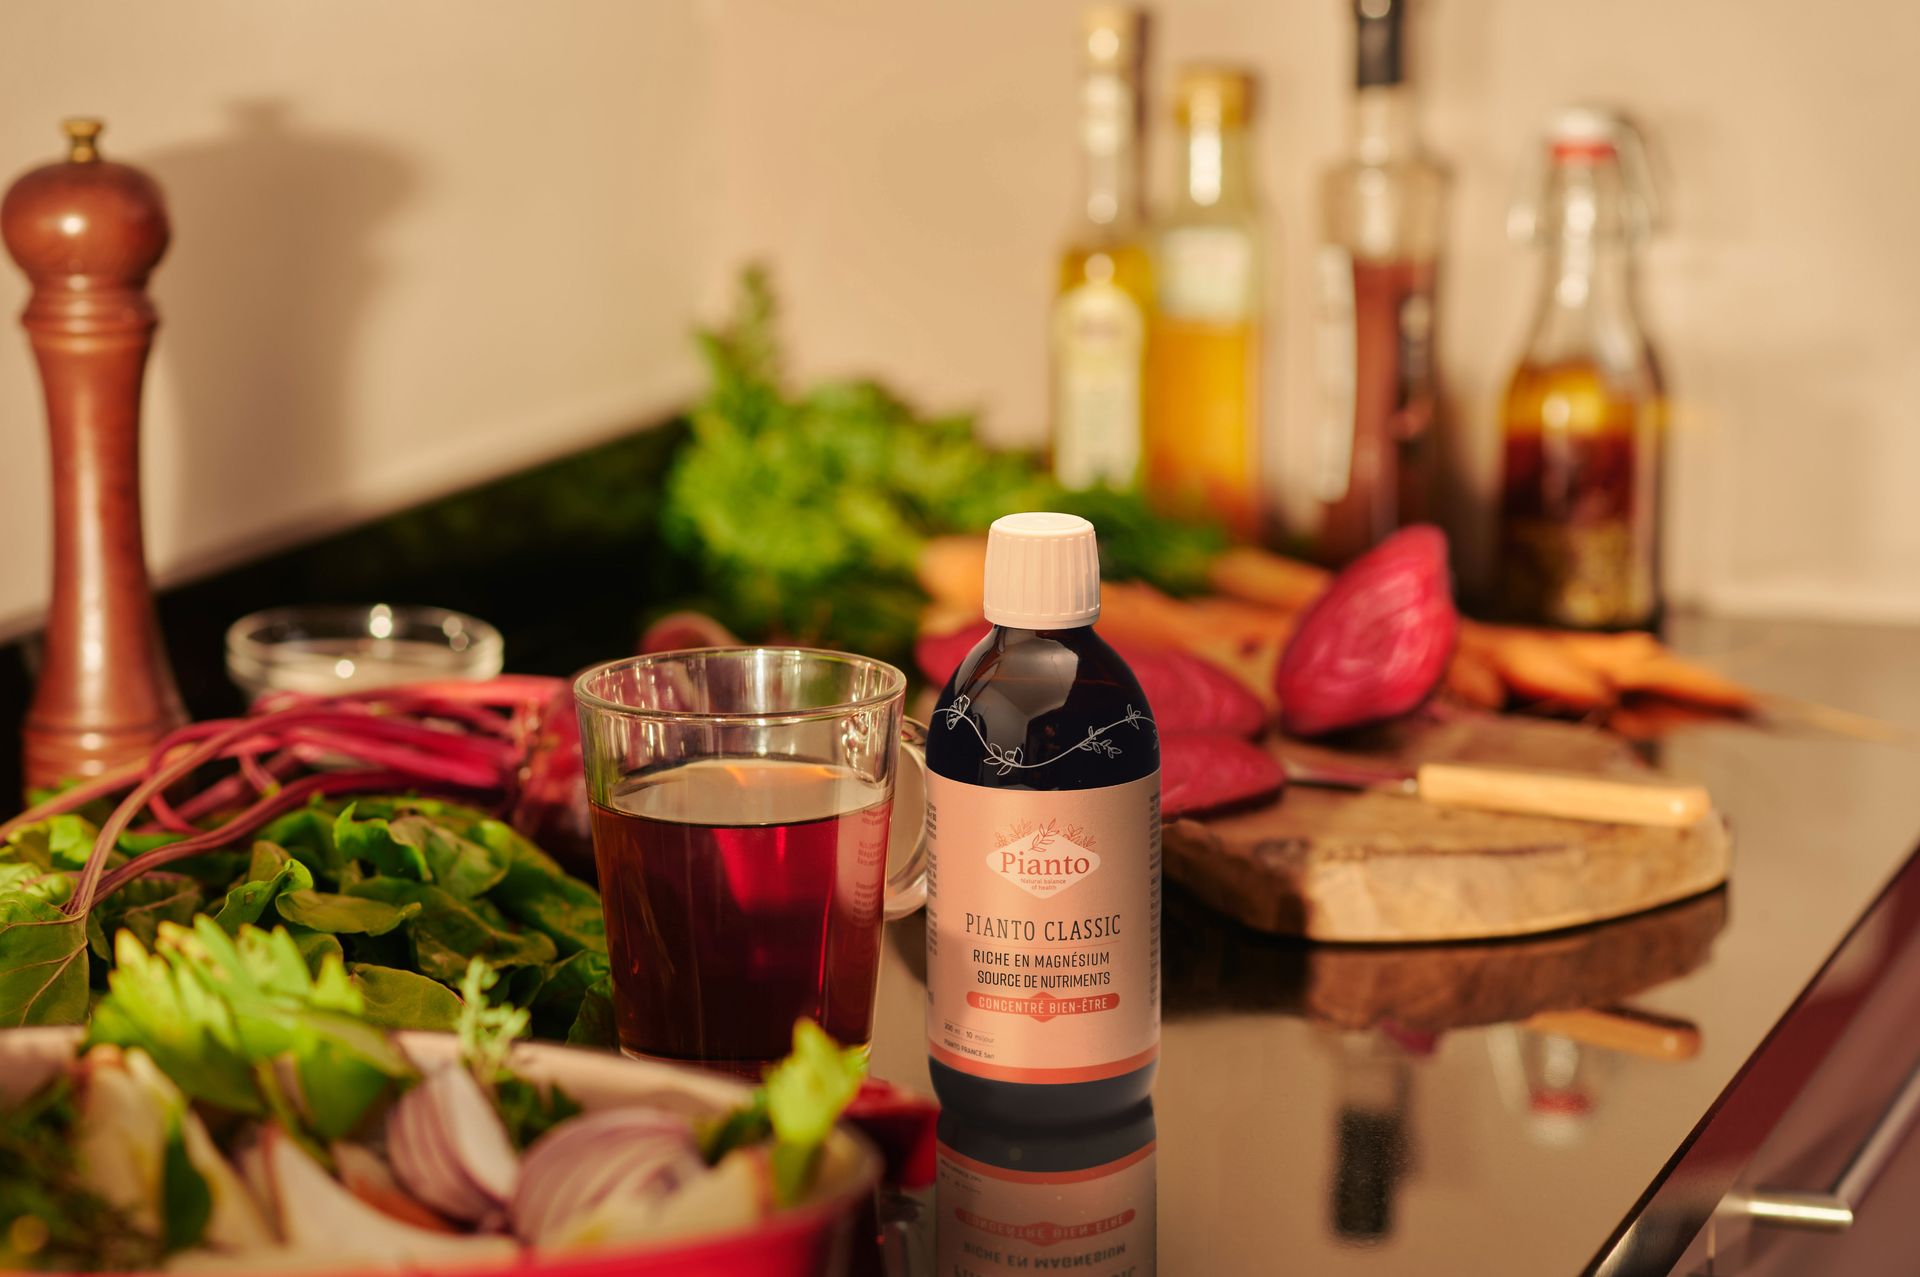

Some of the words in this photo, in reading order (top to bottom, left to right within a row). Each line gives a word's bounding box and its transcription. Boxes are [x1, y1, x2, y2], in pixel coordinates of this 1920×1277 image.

[1000, 851, 1090, 876] Pianto
[1020, 877, 1042, 885] Natural
[1043, 877, 1067, 885] balance
[966, 912, 1035, 941] PIANTO
[1044, 914, 1121, 941] CLASSIC
[973, 949, 1009, 966] RICHE
[1014, 954, 1030, 967] EN
[1034, 951, 1110, 968] MAGNÉSIUM
[977, 970, 1021, 987] SOURCE
[1024, 974, 1038, 988] DE
[1041, 971, 1110, 989] NUTRIMENTS
[978, 996, 1044, 1014] CONCENTRÉ
[1049, 998, 1107, 1013] BIEN-ÊTRE
[966, 1031, 973, 1039] 10
[961, 1045, 983, 1058] FRANCE
